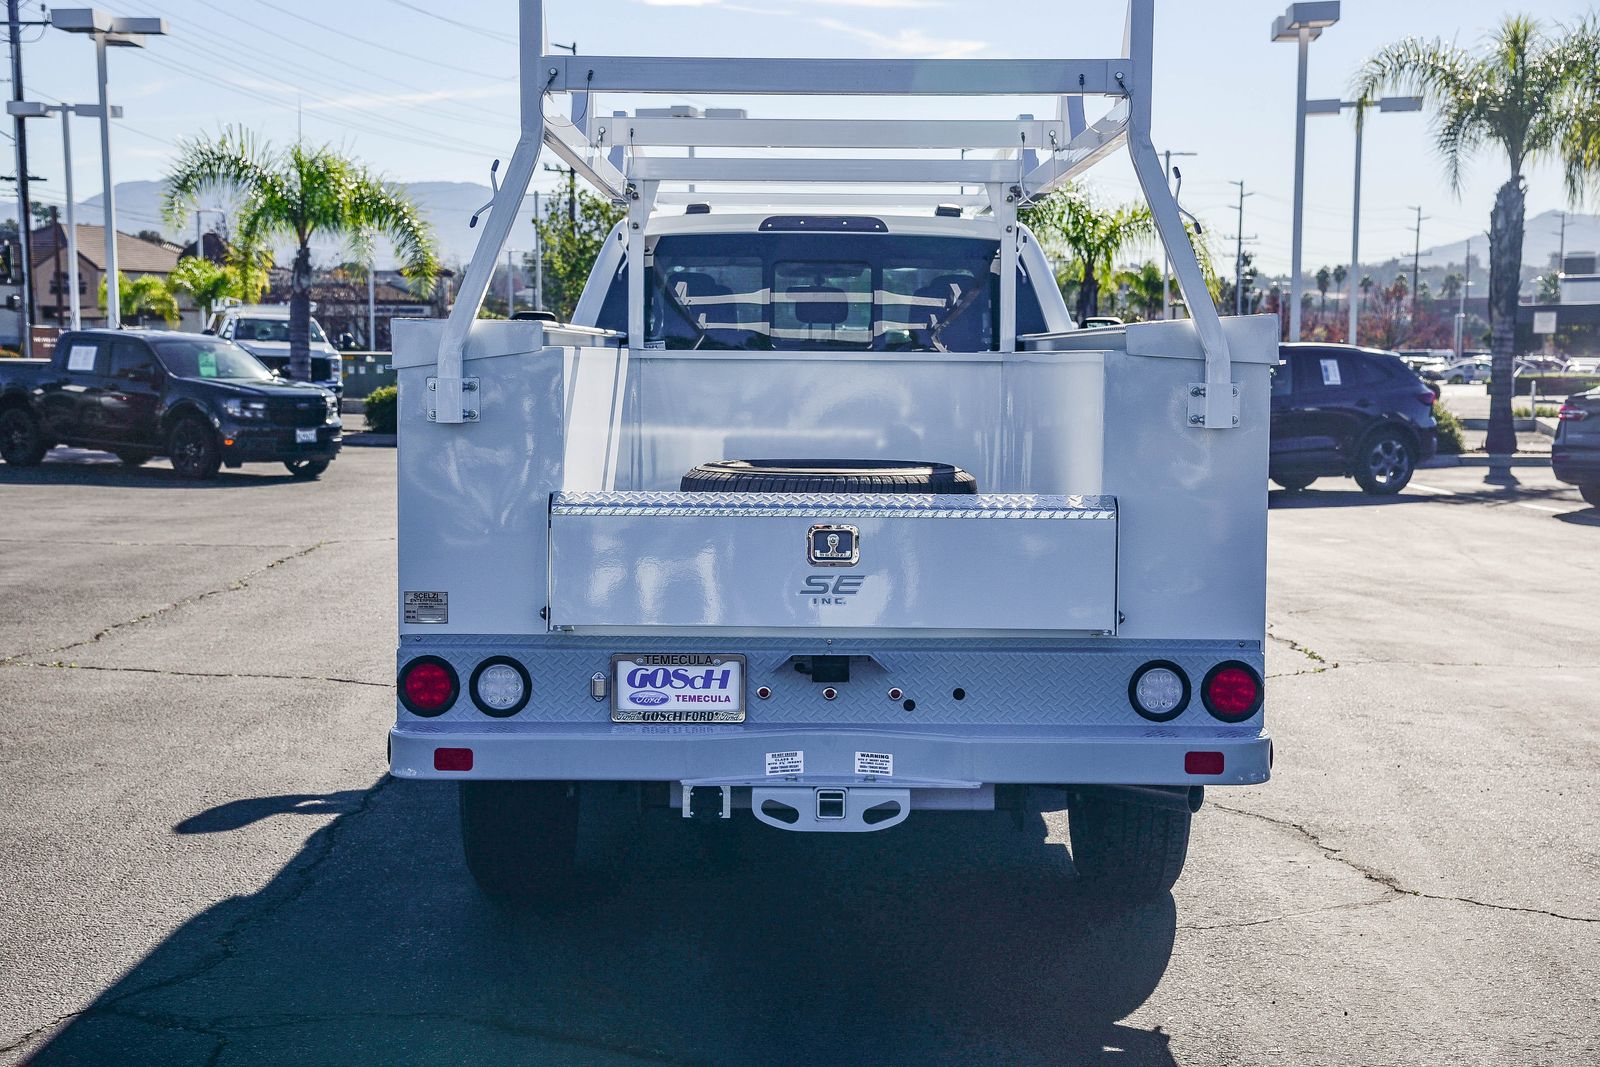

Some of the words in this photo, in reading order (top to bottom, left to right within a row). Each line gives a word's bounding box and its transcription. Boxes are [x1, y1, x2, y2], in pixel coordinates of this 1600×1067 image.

[800, 575, 866, 594] SE
[644, 655, 713, 665] TEMECULA
[635, 694, 663, 704] Ford
[675, 694, 731, 703] TEMECULA
[685, 711, 714, 721] FORD
